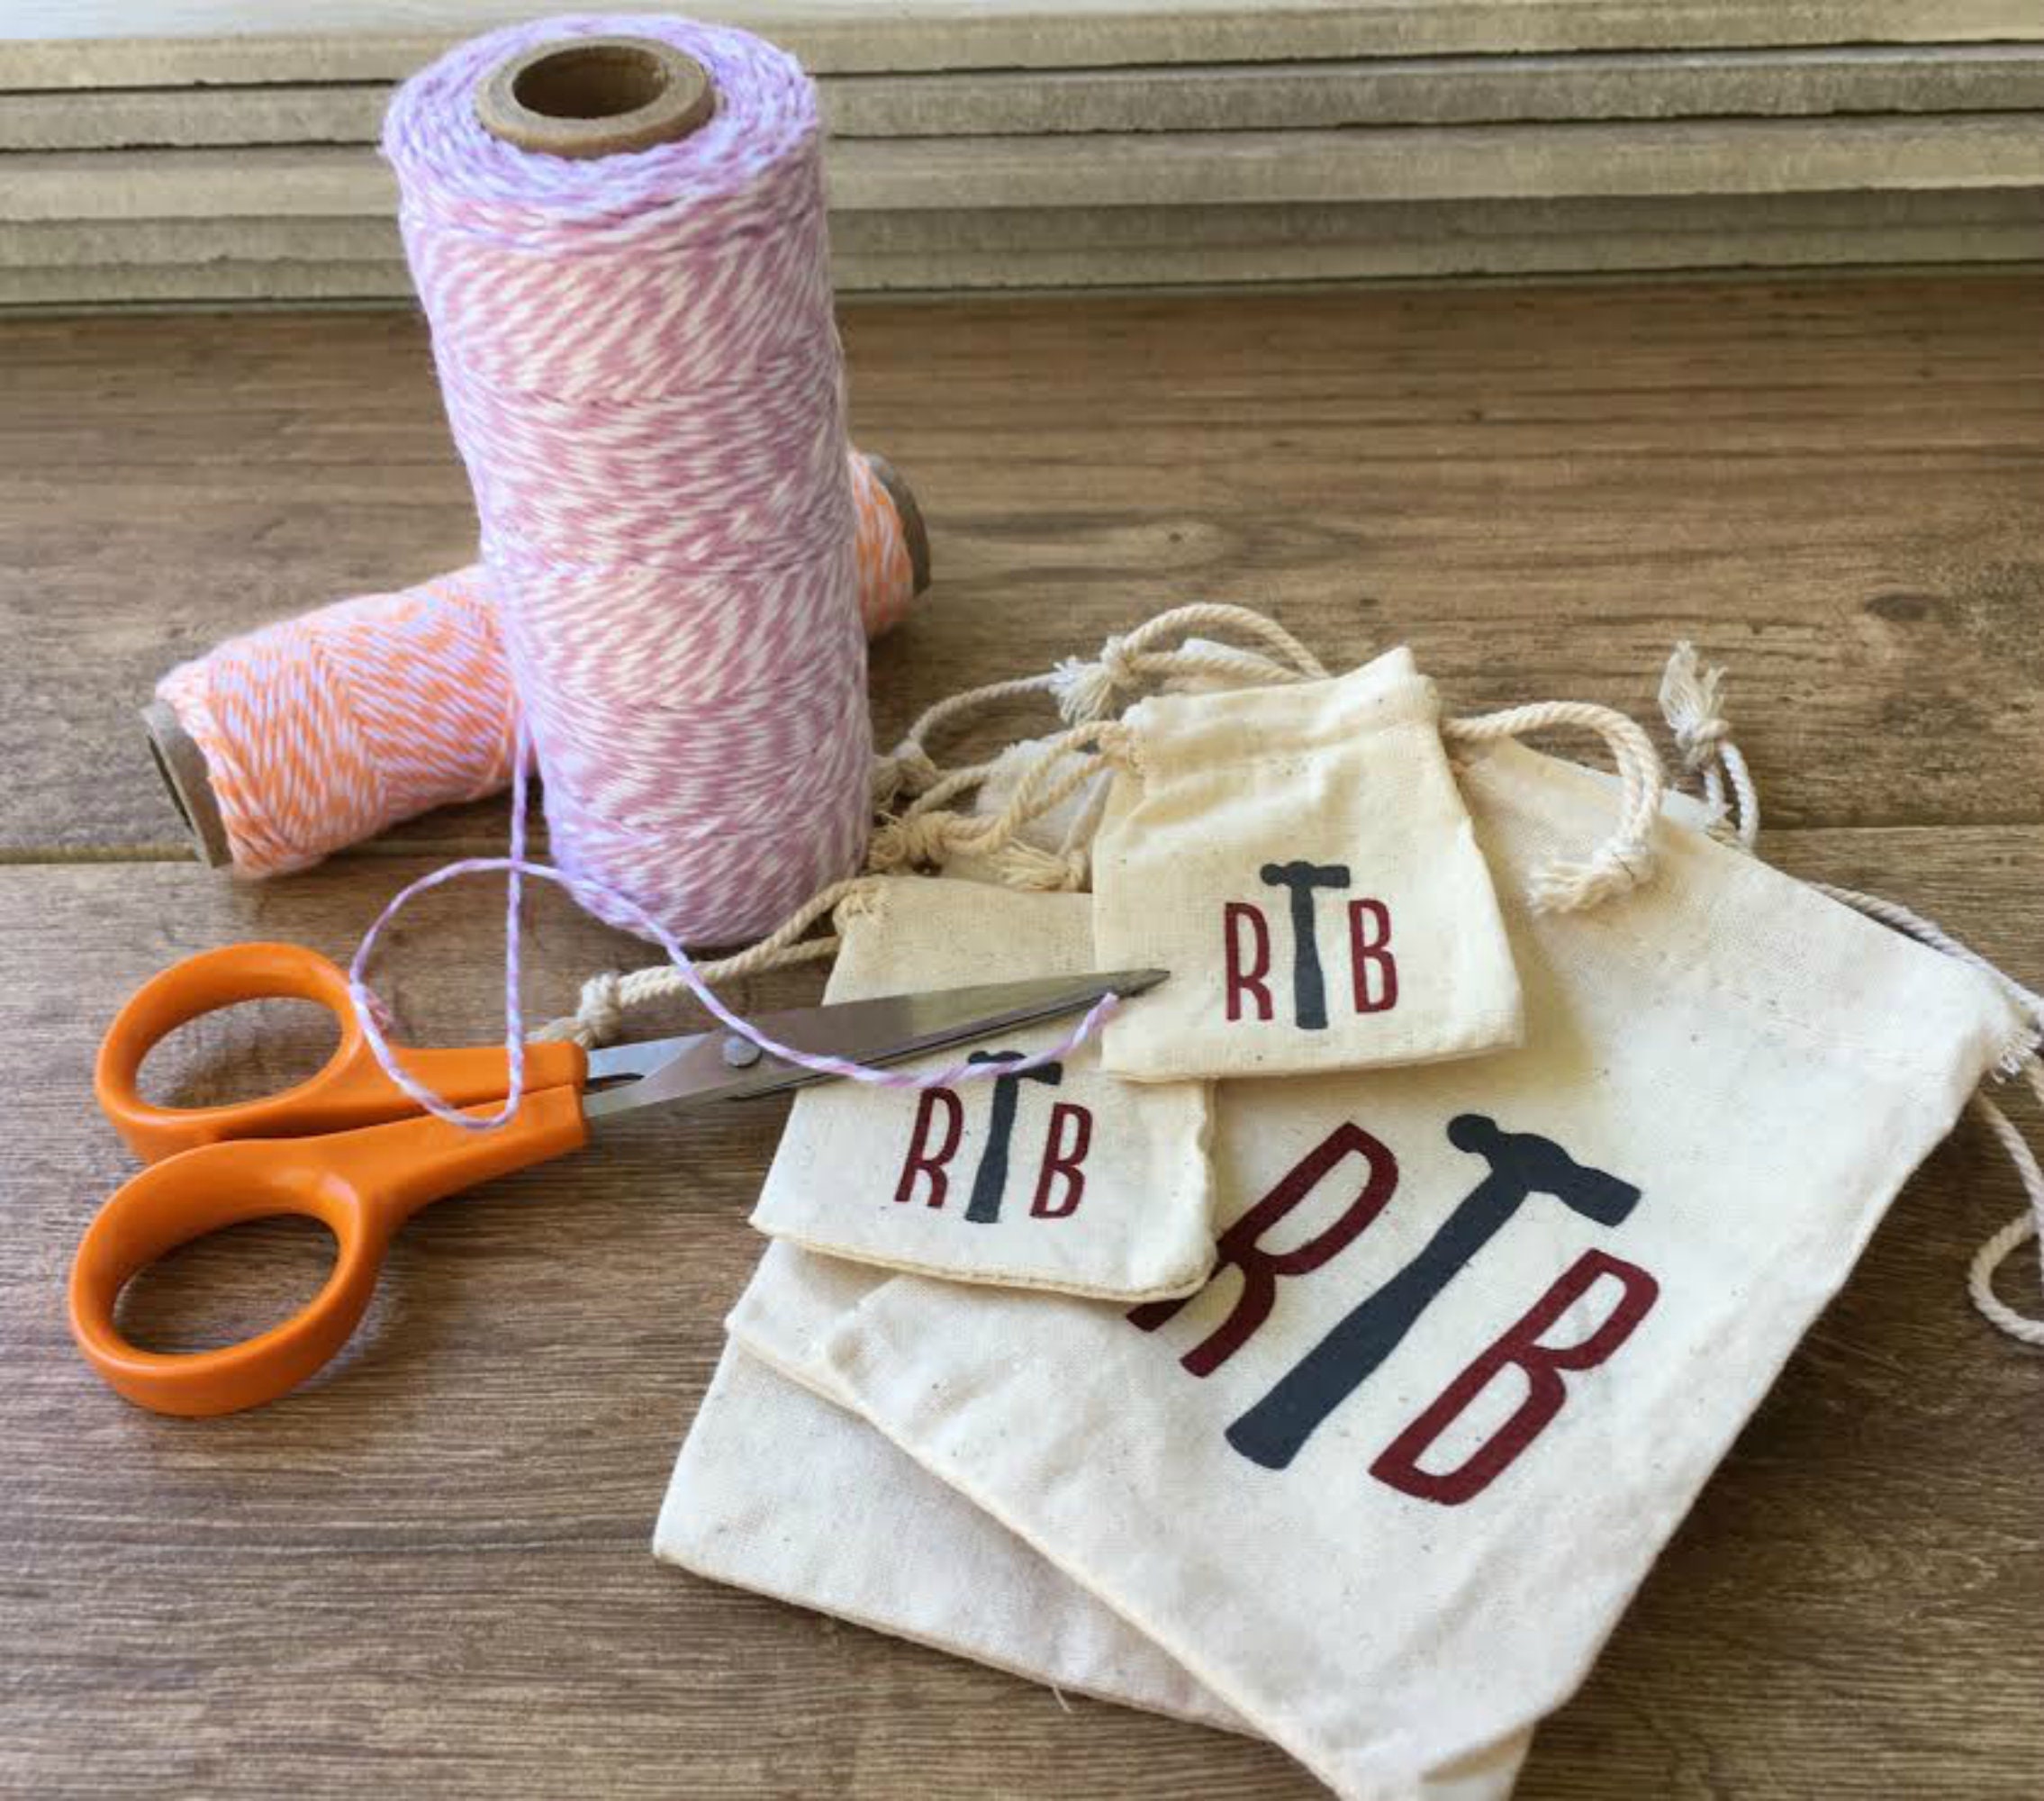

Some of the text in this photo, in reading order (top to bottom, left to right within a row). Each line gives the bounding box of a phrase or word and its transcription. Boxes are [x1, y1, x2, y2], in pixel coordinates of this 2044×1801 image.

[1225, 861, 1398, 1029] RTB
[894, 1050, 1093, 1223] RTB
[1126, 1113, 1660, 1506] RTB
